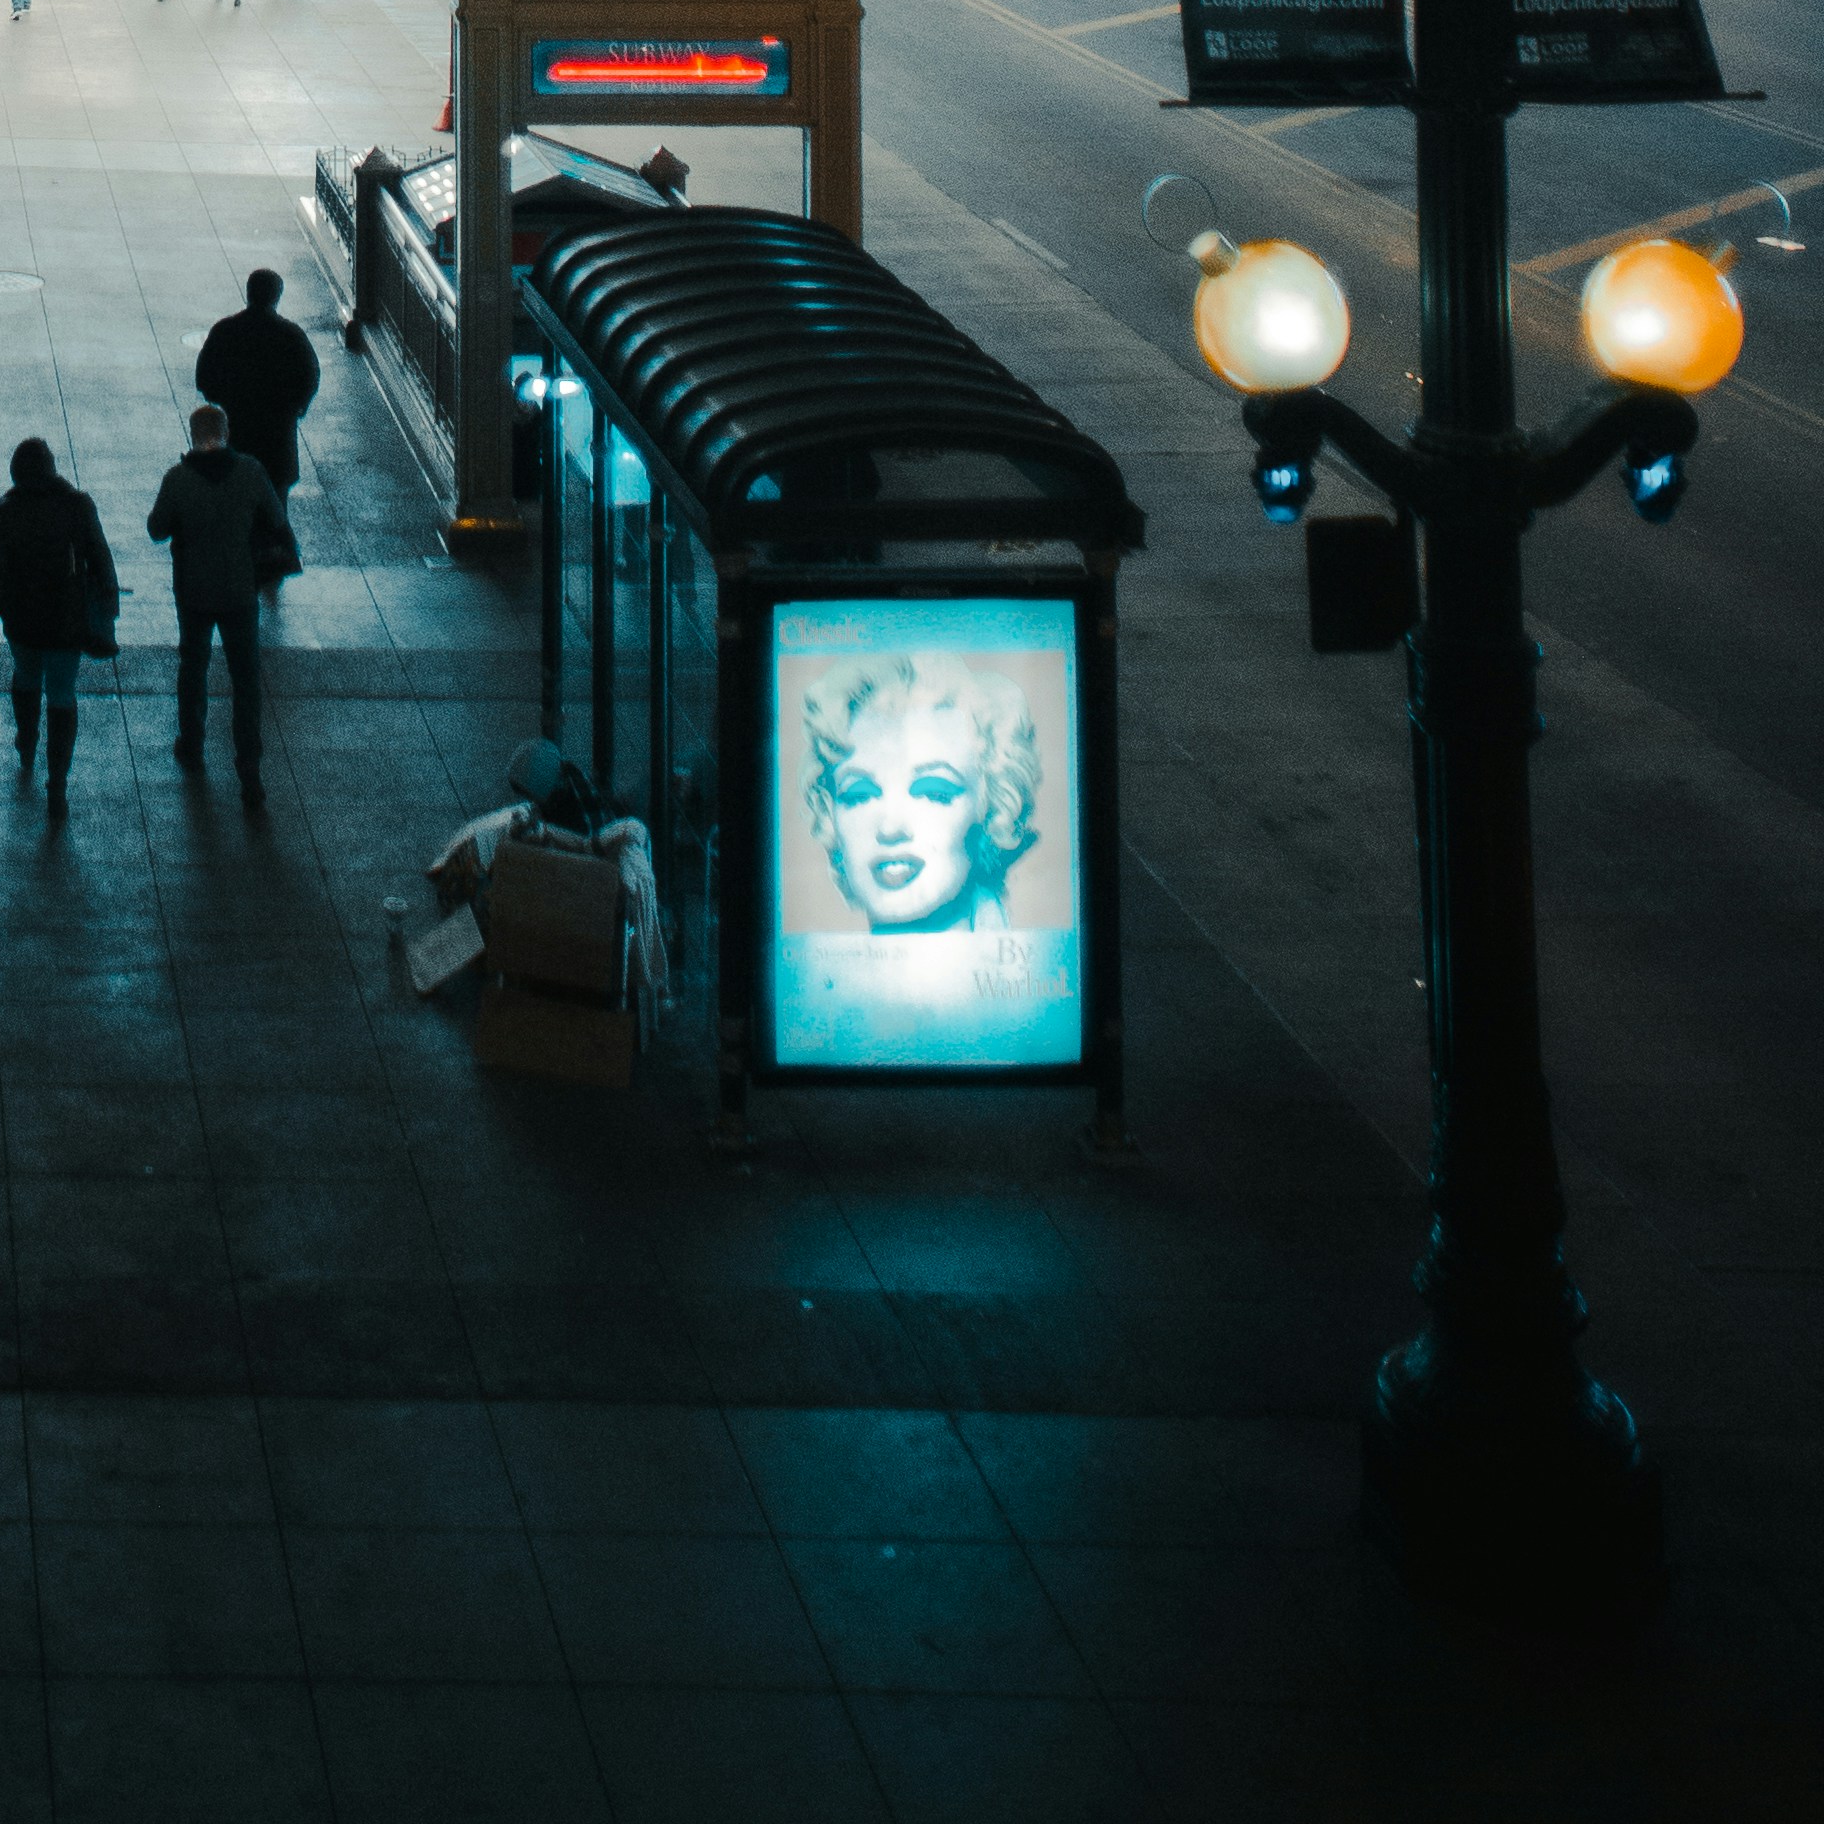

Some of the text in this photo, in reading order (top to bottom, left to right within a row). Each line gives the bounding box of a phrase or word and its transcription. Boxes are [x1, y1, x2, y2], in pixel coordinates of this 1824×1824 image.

[608, 41, 713, 64] SUBWAY
[1229, 38, 1280, 51] LOOP
[1540, 42, 1591, 55] LOOP
[995, 935, 1034, 968] By
